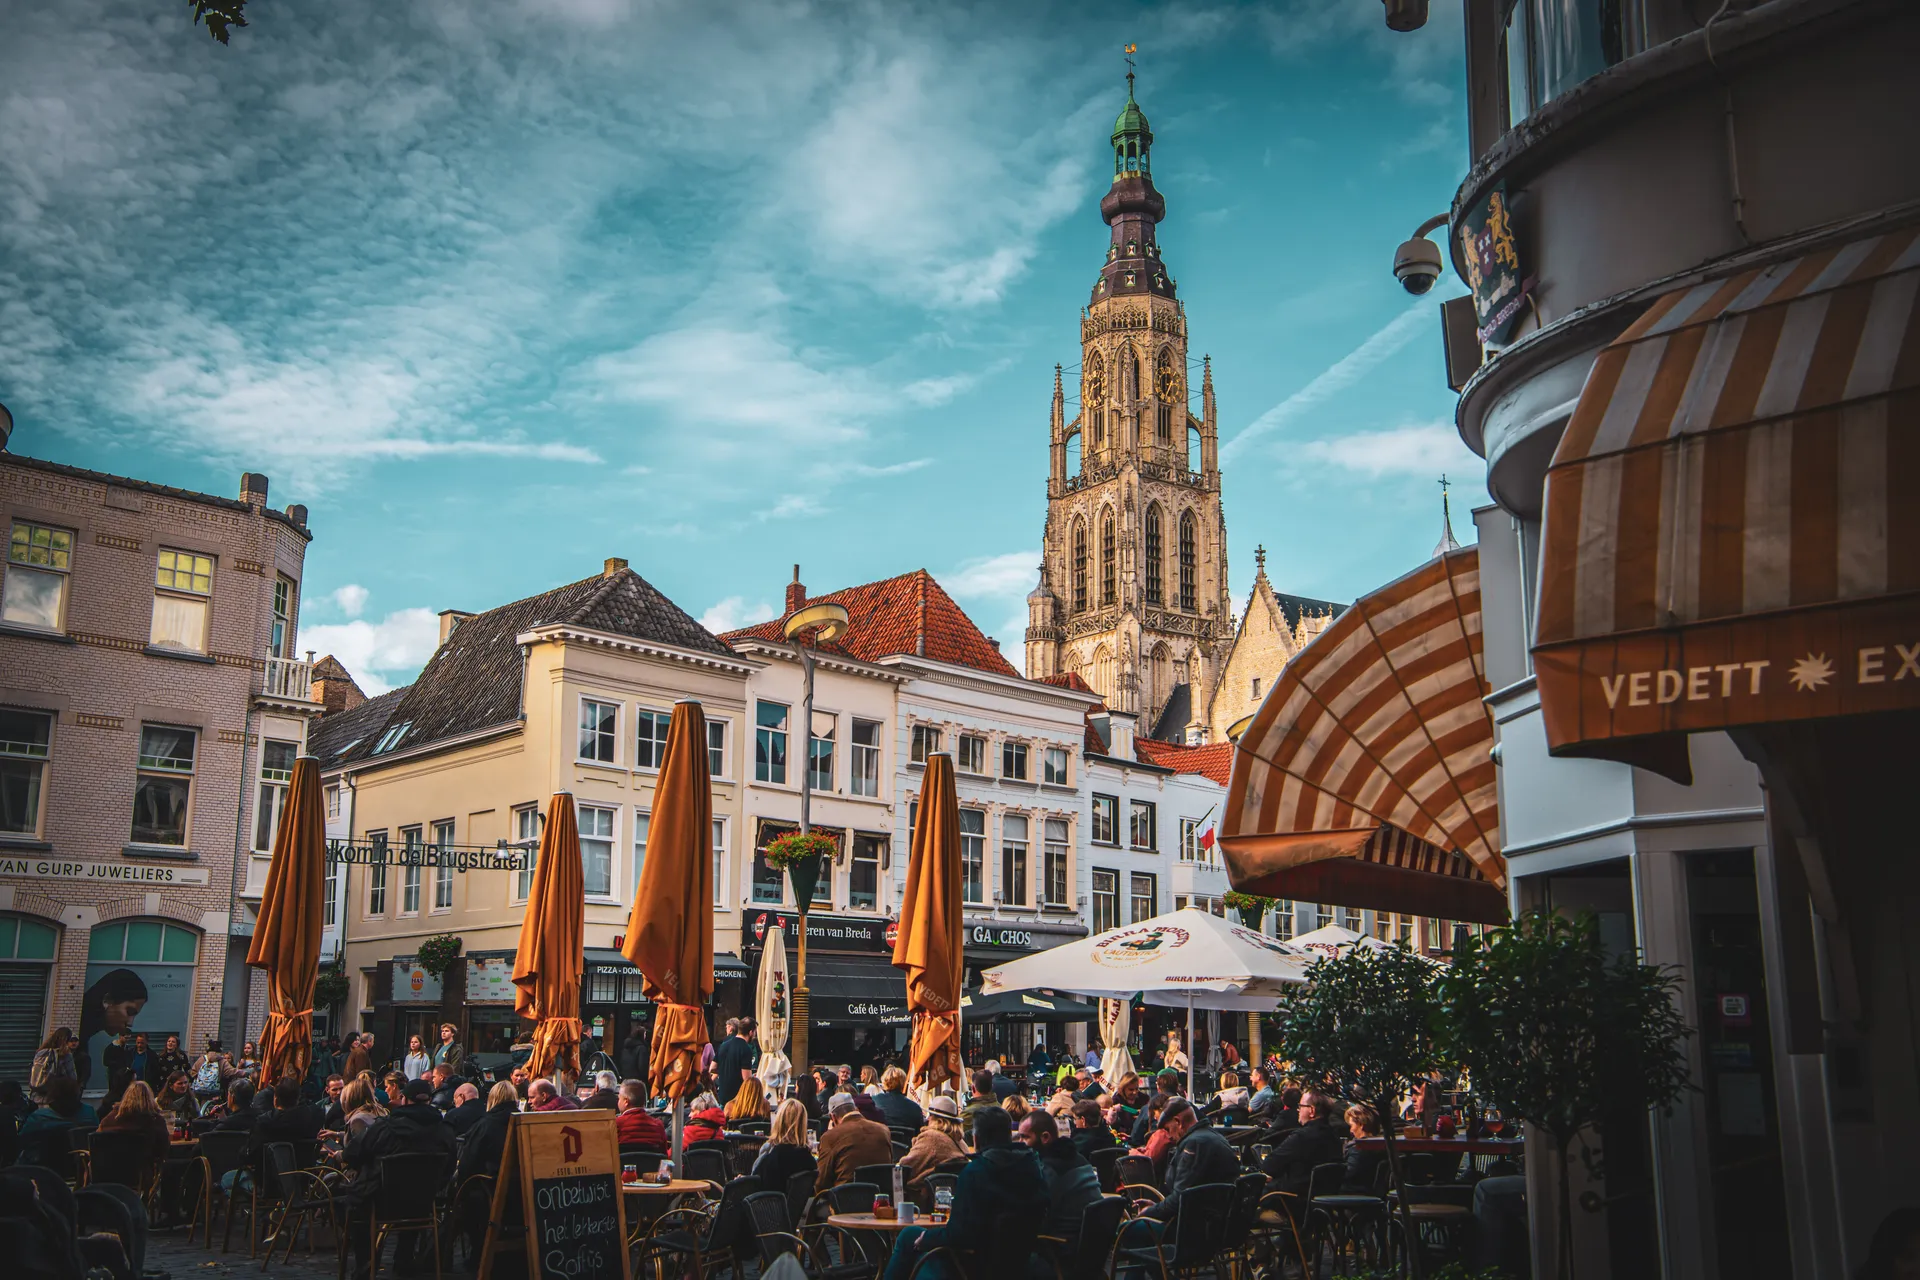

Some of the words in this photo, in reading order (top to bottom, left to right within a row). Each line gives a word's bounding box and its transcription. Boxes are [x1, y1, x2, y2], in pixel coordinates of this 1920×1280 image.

[1497, 298, 1520, 325] BREDA
[1600, 660, 1770, 709] VEDETT
[1858, 642, 1920, 684] EX
[36, 862, 83, 876] GURP
[87, 865, 173, 881] JUWELIERS
[791, 923, 825, 936] Heren
[827, 928, 843, 938] van
[845, 927, 871, 939] Breda
[973, 926, 1031, 945] GAUCHOS
[1096, 927, 1149, 948] BIRRA
[1152, 926, 1190, 948] MORETTI
[597, 966, 618, 974] PIZZA
[713, 970, 742, 978] CHICKEN
[919, 983, 951, 1010] VEDETT
[848, 1003, 867, 1015] Café
[868, 1004, 878, 1015] de
[544, 1216, 569, 1244] het
